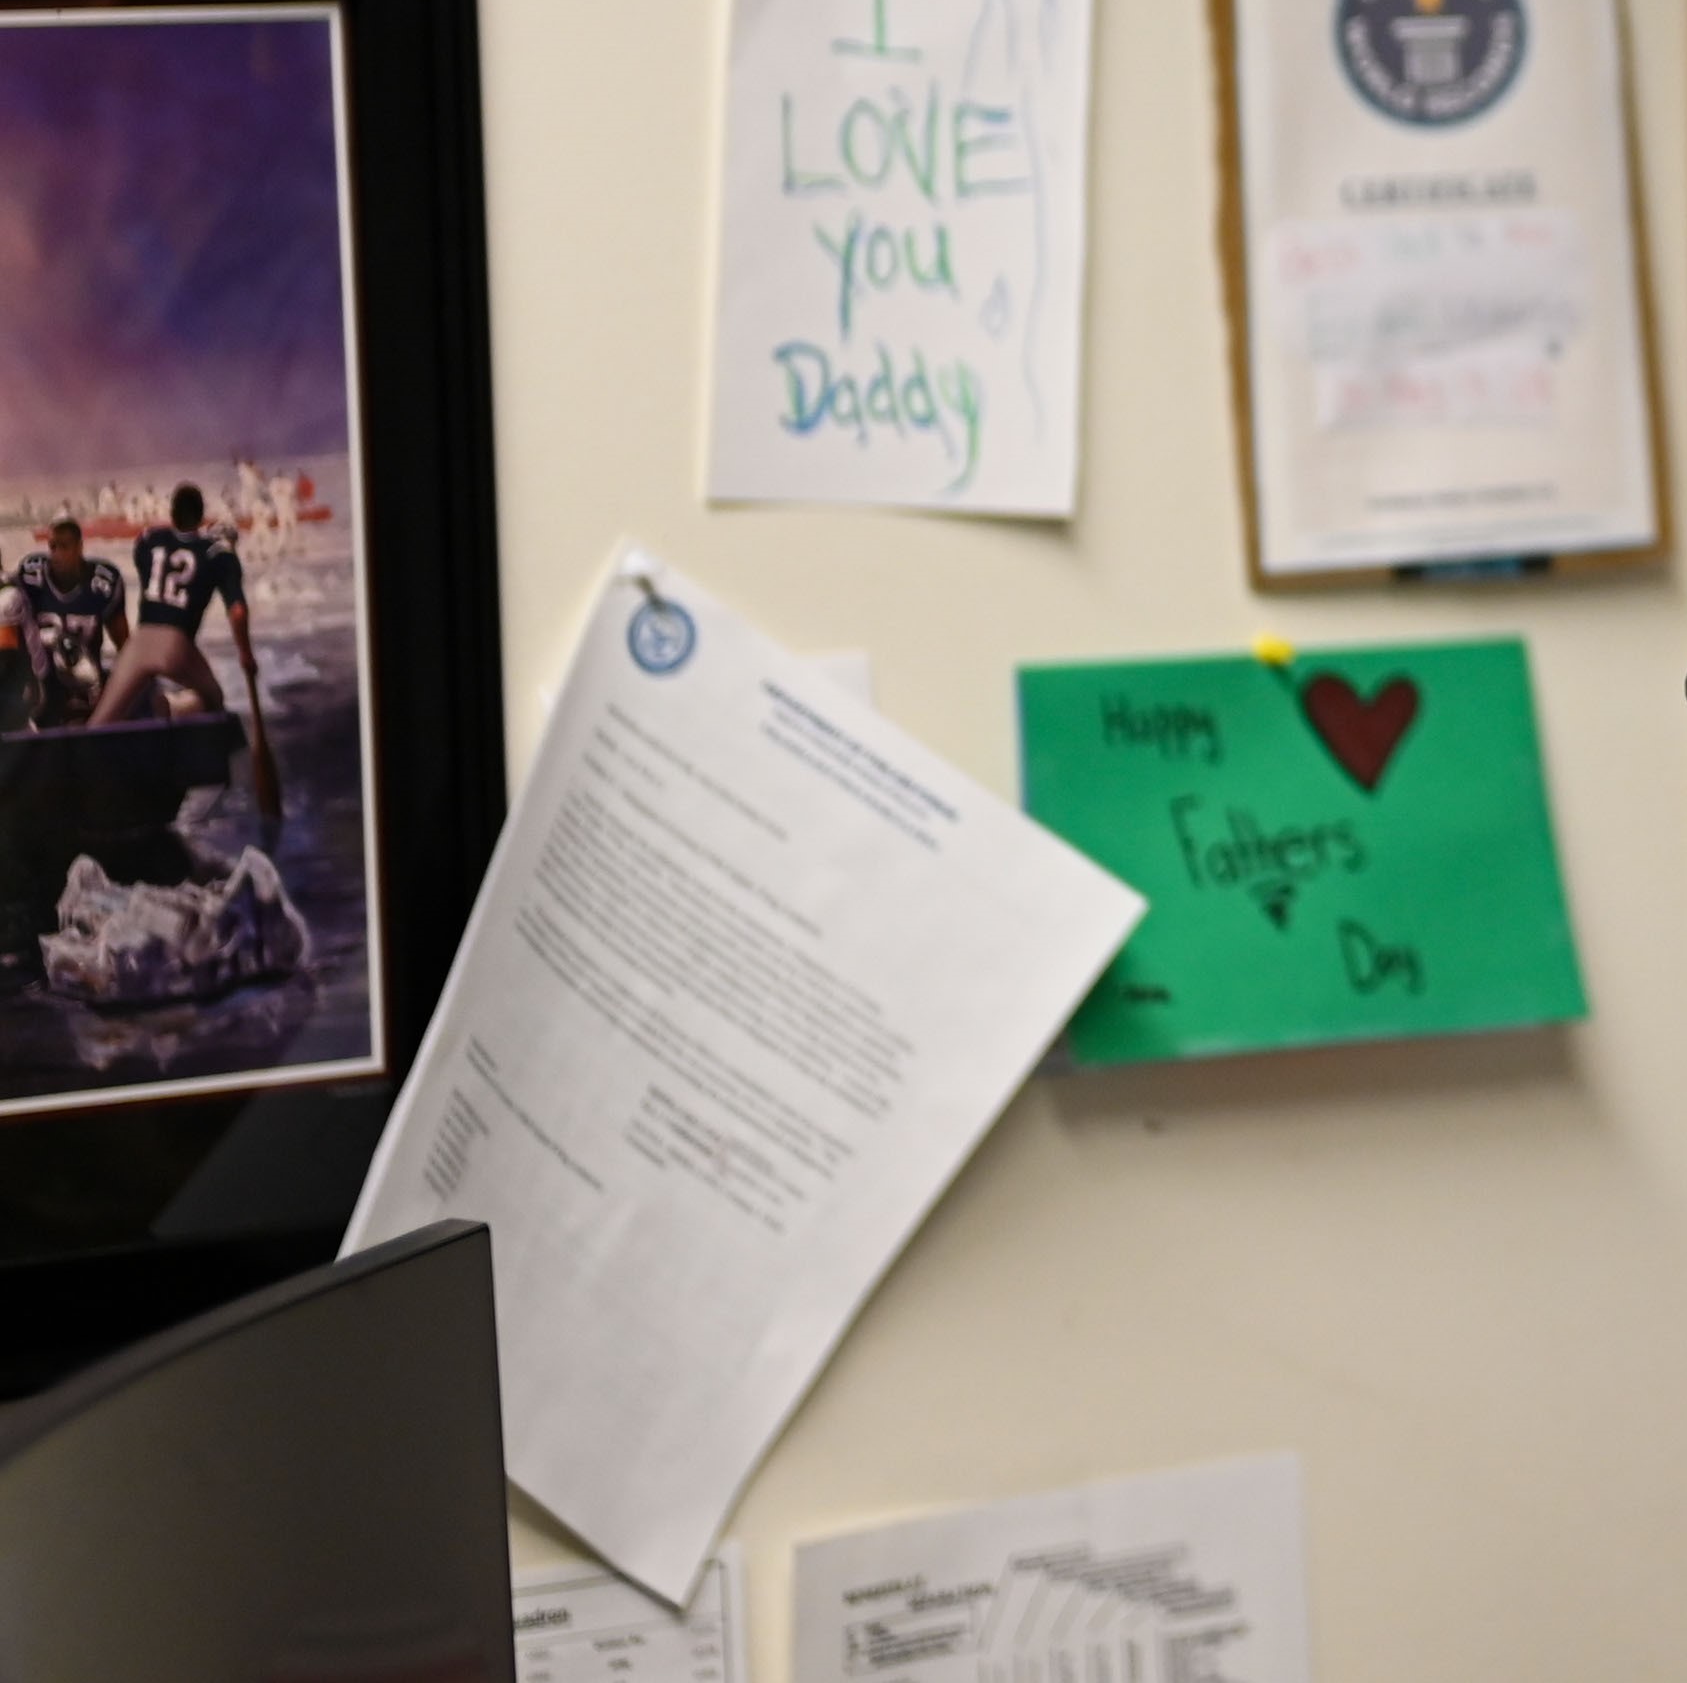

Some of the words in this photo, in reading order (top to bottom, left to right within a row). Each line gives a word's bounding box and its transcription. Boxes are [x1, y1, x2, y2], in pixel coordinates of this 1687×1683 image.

[781, 80, 1034, 206] LOVE
[772, 339, 990, 496] Daddy
[145, 546, 196, 609] 12
[1102, 693, 1223, 766] Happy
[1339, 918, 1425, 996] Day
